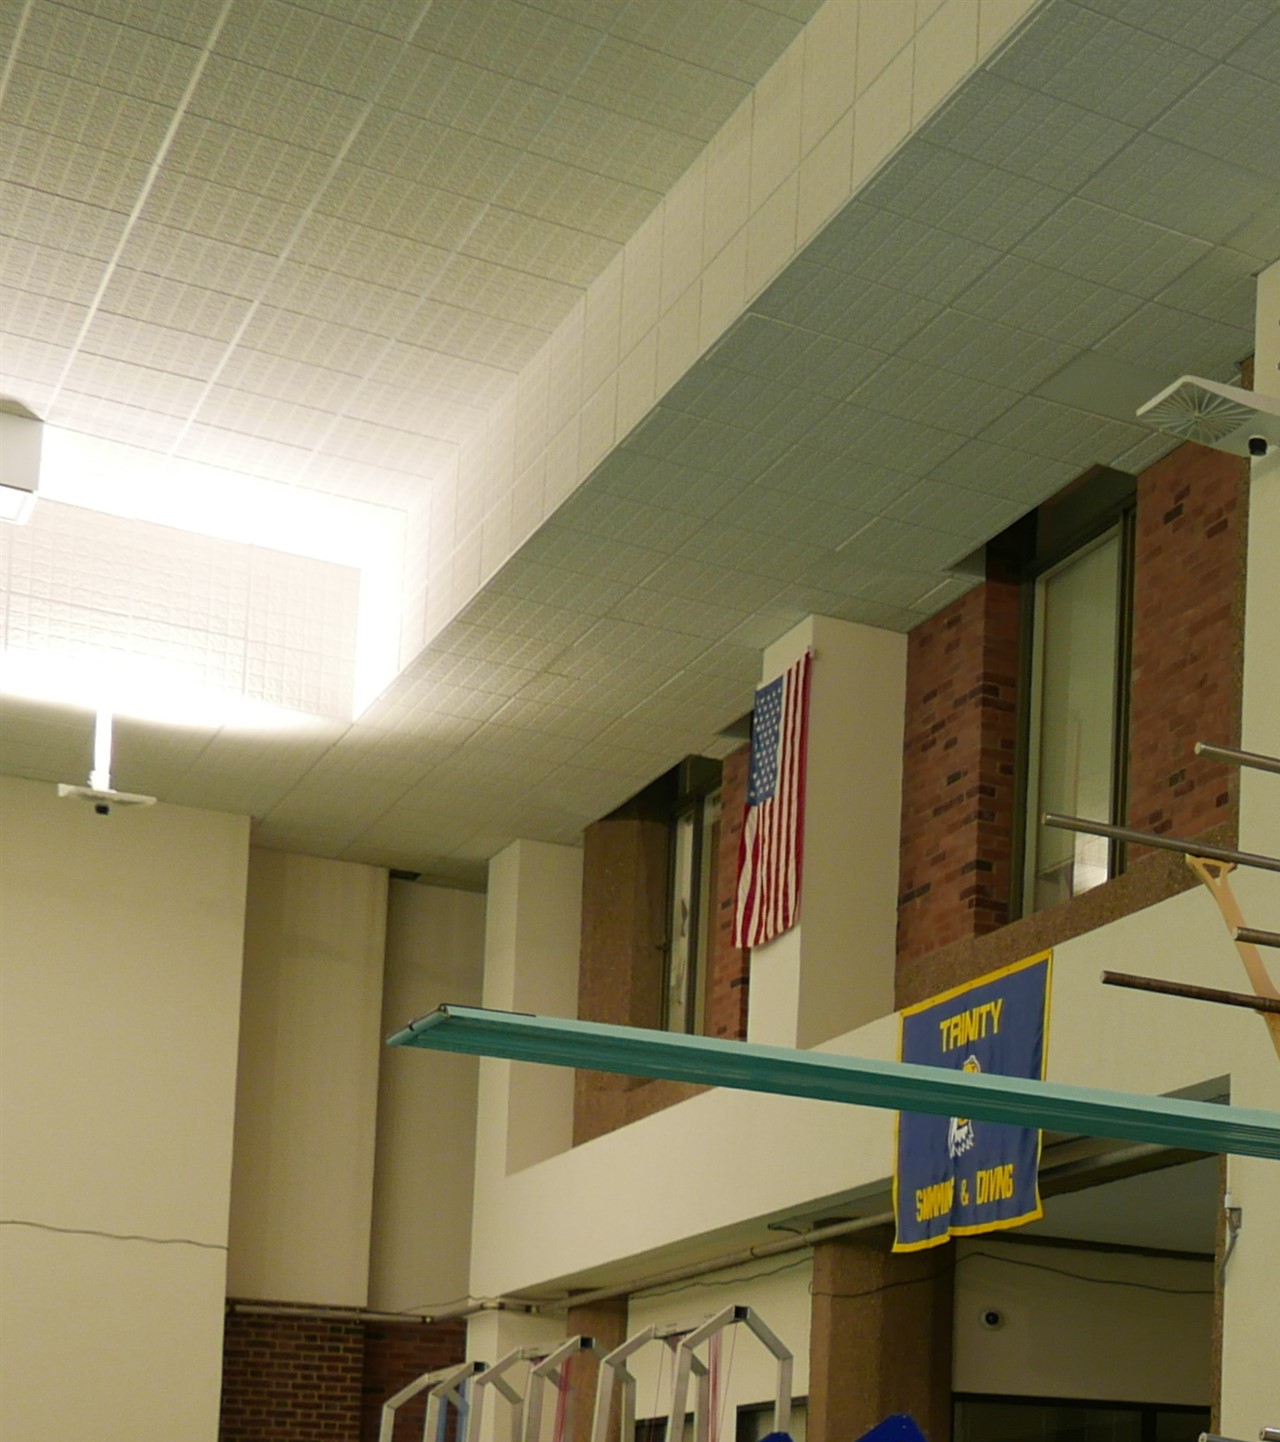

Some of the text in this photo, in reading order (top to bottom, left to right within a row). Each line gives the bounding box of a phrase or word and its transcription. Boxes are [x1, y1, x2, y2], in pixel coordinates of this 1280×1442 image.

[939, 998, 1004, 1053] TRINITY
[960, 1178, 970, 1206] &
[975, 1163, 1014, 1205] DIVING
